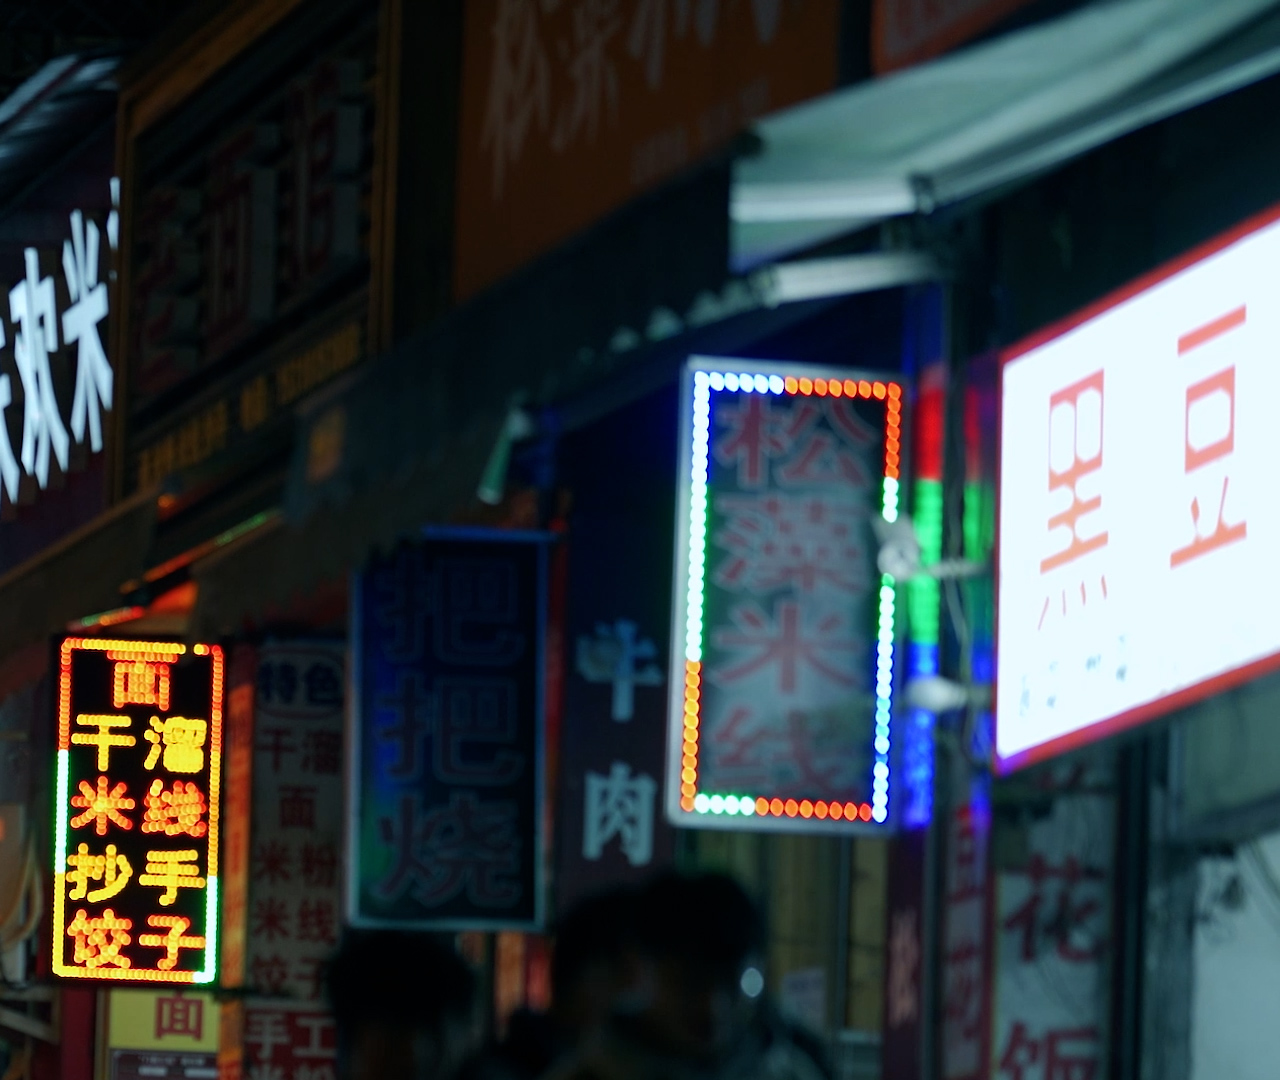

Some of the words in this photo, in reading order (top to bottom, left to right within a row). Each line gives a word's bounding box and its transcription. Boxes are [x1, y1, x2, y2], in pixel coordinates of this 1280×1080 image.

[107, 650, 178, 710] 面
[258, 662, 344, 706] 特色
[71, 714, 207, 773] 干溜
[370, 548, 530, 908] 把把烧
[576, 616, 664, 867] 牛肉
[70, 776, 207, 837] 米线
[278, 783, 317, 827] 面
[67, 843, 206, 906] 抄手
[253, 840, 338, 887] 米粉
[67, 909, 206, 970] 饺子
[244, 1012, 338, 1061] 手工
